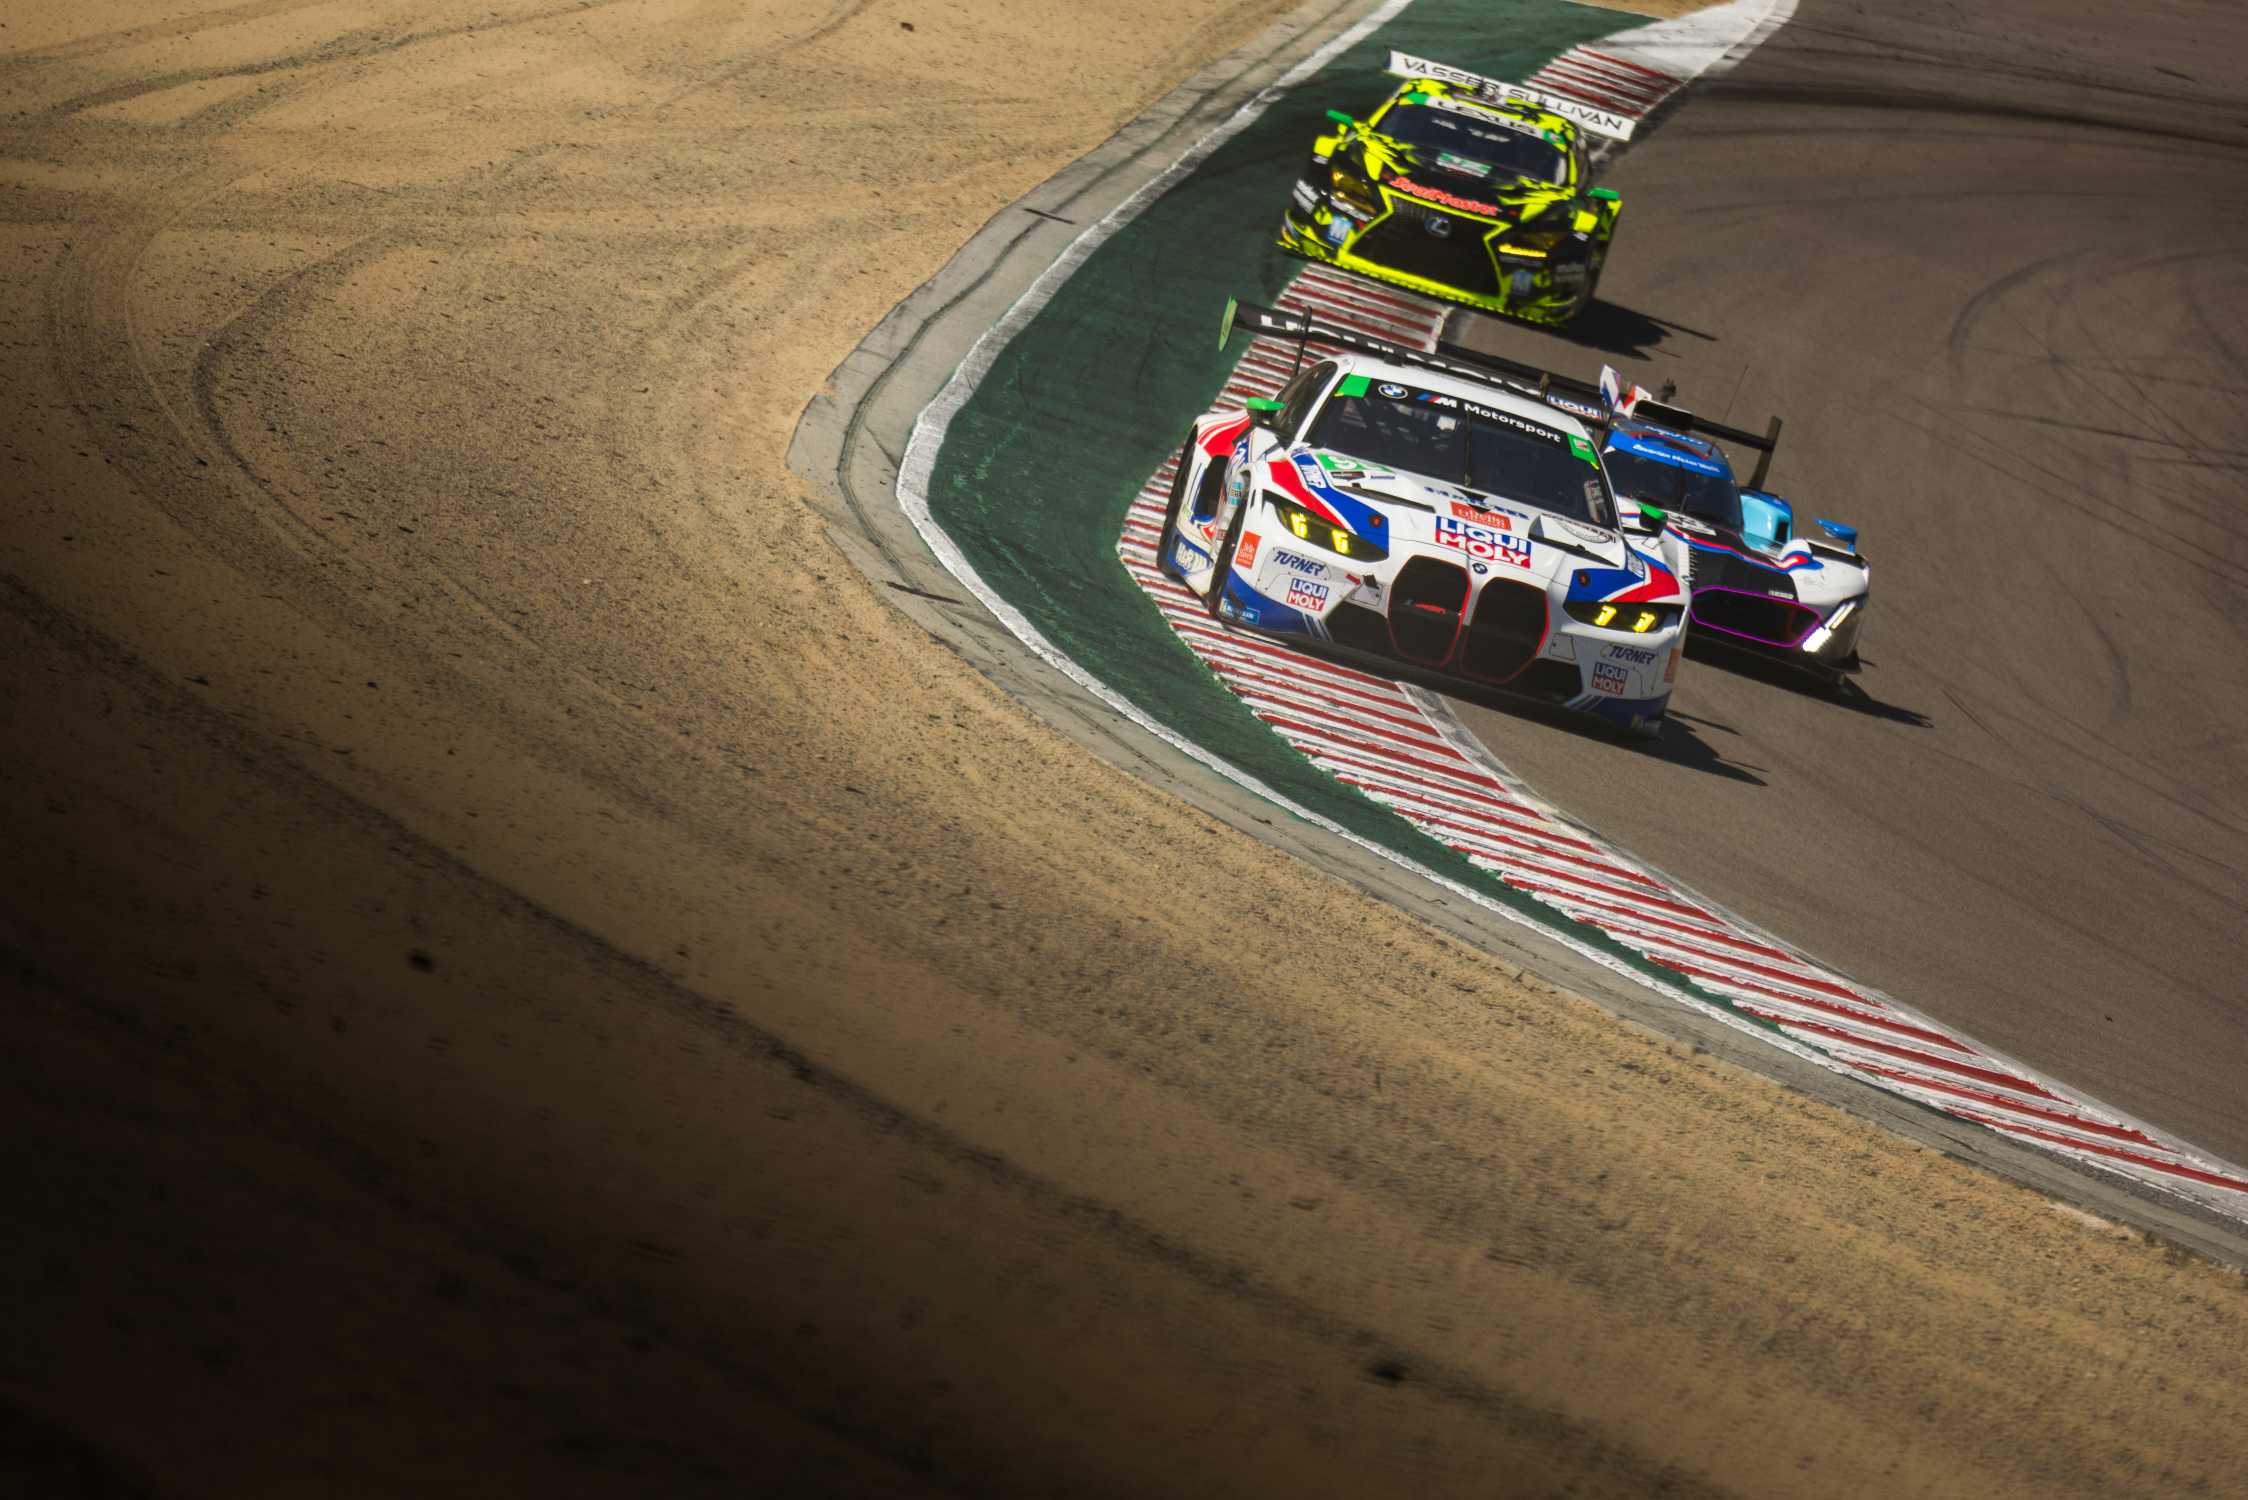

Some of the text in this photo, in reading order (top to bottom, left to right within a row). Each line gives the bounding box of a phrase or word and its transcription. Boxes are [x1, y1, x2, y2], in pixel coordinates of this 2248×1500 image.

[1403, 57, 1622, 131] VASSER SULLIVAN
[1437, 101, 1535, 135] LEXUS
[1464, 403, 1562, 443] Motorsport
[1439, 516, 1528, 553] LIQUI
[1438, 532, 1529, 567] MOLY
[1273, 550, 1326, 577] TURNER
[1287, 591, 1324, 611] MOLY
[1291, 578, 1328, 599] LIQUI
[1609, 645, 1656, 665] TURNER
[1595, 663, 1628, 680] LIQUI
[1592, 677, 1624, 695] MOLY
